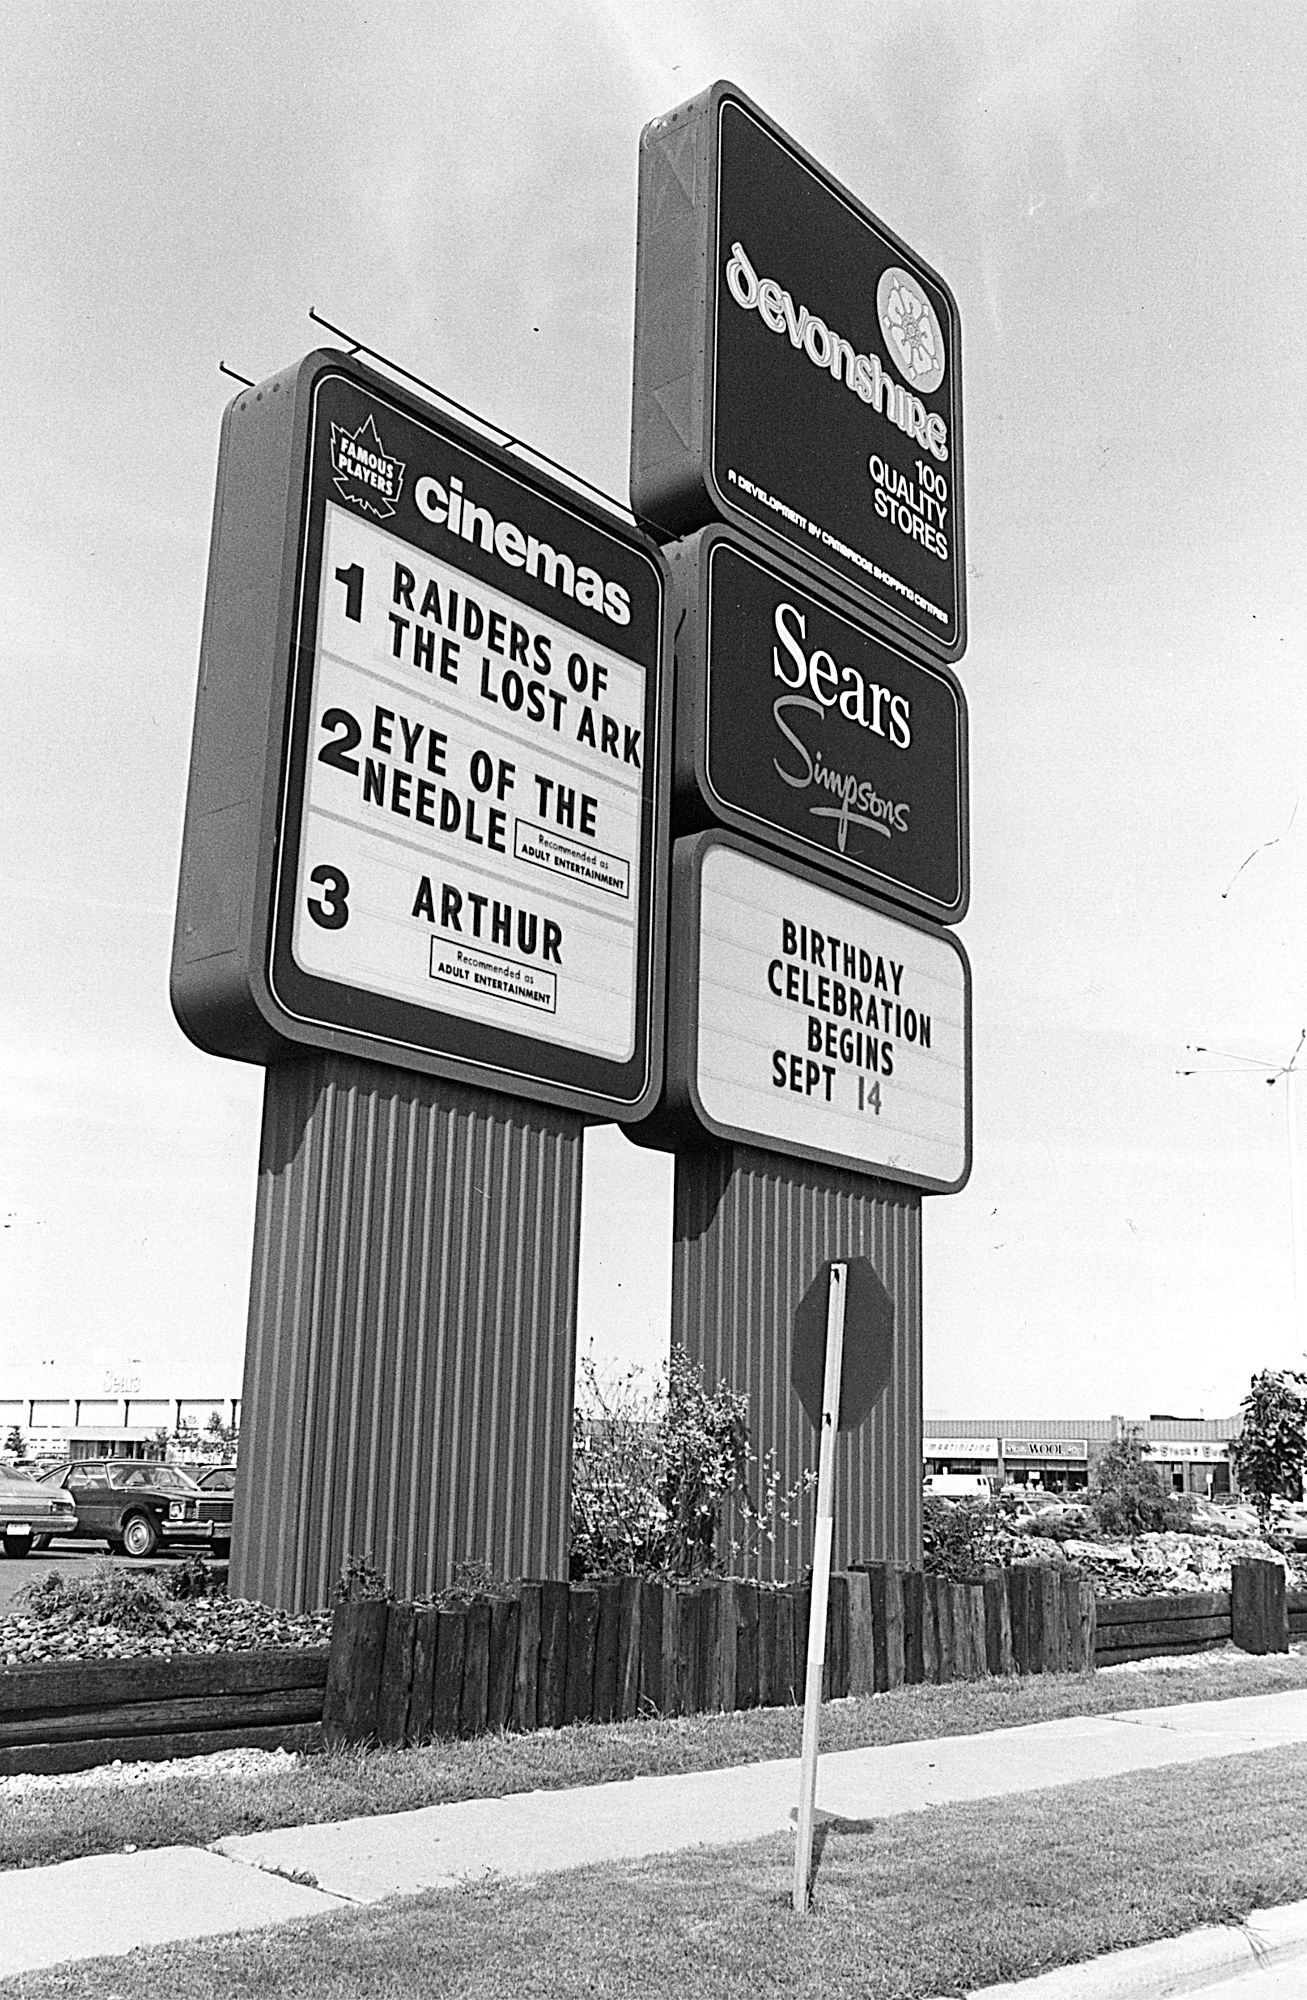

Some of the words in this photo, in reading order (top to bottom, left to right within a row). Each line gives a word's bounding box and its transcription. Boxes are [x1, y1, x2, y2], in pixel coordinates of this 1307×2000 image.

[726, 242, 949, 461] devonshire
[339, 454, 393, 496] PLAYERS
[341, 438, 394, 479] FAMOUS
[870, 455, 947, 530] QUALITY
[915, 460, 947, 502] 100
[415, 476, 632, 625] cinemas
[728, 469, 736, 484] A
[738, 475, 807, 530] DEVELOPMENT
[808, 522, 821, 538] BY
[822, 531, 873, 574] CAMBRIDGE
[873, 566, 914, 601] SHOPPING
[874, 488, 948, 560] STORES
[335, 563, 365, 623] 1
[392, 561, 552, 676] RAIDERS
[567, 652, 608, 702] OF
[388, 611, 461, 685] THE
[480, 657, 568, 732] LOST
[576, 705, 641, 769] ARK
[773, 603, 911, 749] Sears
[317, 707, 362, 777] 2
[372, 705, 448, 778] EYE
[470, 750, 516, 801] OF
[534, 773, 599, 838] THE
[363, 757, 506, 854] NEEDLE
[773, 694, 910, 853] Simpsons
[522, 844, 551, 862] ADULT
[554, 856, 624, 889] ENTERTAINMENT
[539, 834, 597, 865] Recommended
[600, 861, 609, 869] as
[307, 864, 350, 931] 3
[411, 875, 563, 965] ARTHUR
[438, 962, 470, 980] ADULT
[474, 973, 551, 1004] ENTERTAINMENT
[457, 951, 521, 980] Recommended
[524, 974, 534, 984] as
[782, 917, 904, 997] BIRTHDAY
[767, 959, 931, 1048] CELEBRATION
[772, 1050, 836, 1102] SEPT
[858, 1076, 882, 1115] 14
[807, 1015, 894, 1076] BEGINS
[103, 1370, 141, 1393] Sears
[1028, 1443, 1066, 1455] WOOL
